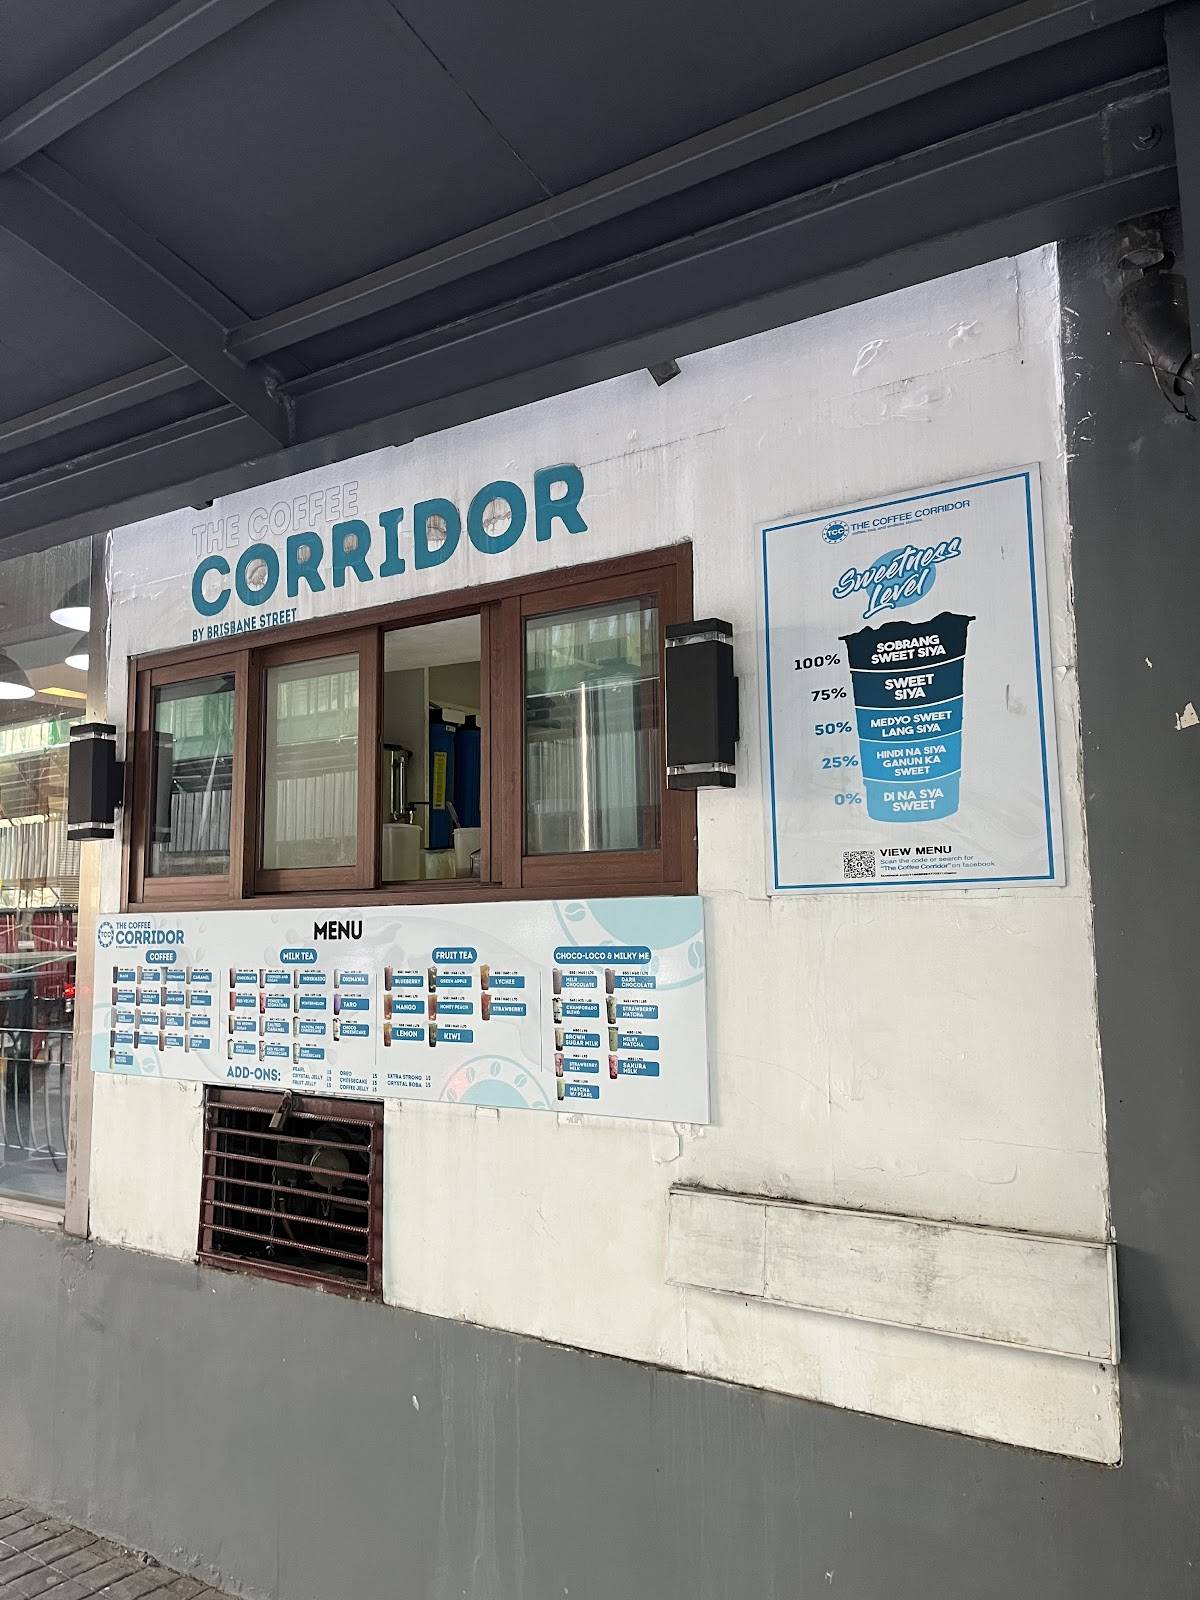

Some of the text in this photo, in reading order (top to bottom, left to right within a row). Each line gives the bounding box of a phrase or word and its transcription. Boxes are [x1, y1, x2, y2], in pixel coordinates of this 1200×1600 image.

[192, 481, 359, 559] THE COFFEE
[850, 500, 970, 531] THE COFFEE CORRIDOR
[827, 527, 844, 537] TCC
[192, 463, 588, 617] CORRIDOR
[833, 537, 961, 599] Sweetness
[863, 568, 929, 619] Level
[192, 607, 297, 642] BY BRISBANE STREET
[876, 635, 940, 653] SOBRANG
[794, 653, 841, 670] 100%
[871, 644, 947, 665] SWEET SIYA
[884, 673, 935, 690] SWEET
[811, 687, 847, 702] 75%
[894, 687, 926, 701] SIYA
[870, 710, 953, 729] MEDYO SWEET
[814, 721, 852, 736] 50%
[882, 723, 942, 738] LANG SIYA
[876, 745, 947, 760] HINDI NA SIYA
[821, 755, 859, 770] 25%
[882, 755, 941, 768] GANUN KA
[894, 766, 931, 777] SWEET
[834, 793, 862, 806] 0%
[884, 788, 944, 802] DI NA SYA
[892, 799, 937, 812] SWEET
[880, 845, 952, 857] VIEW MENU
[128, 921, 151, 929] COFFEE
[313, 920, 363, 940] MENU
[116, 930, 185, 945] CORRIDOR
[150, 952, 174, 961] COFFEE
[283, 951, 315, 961] MILK TEA
[436, 951, 473, 960] FRUIT TEA
[555, 951, 650, 960] CHOCO-LOCO & MILKY ME
[443, 1032, 460, 1040] KIWI
[227, 1065, 281, 1082] ADD-ONS:
